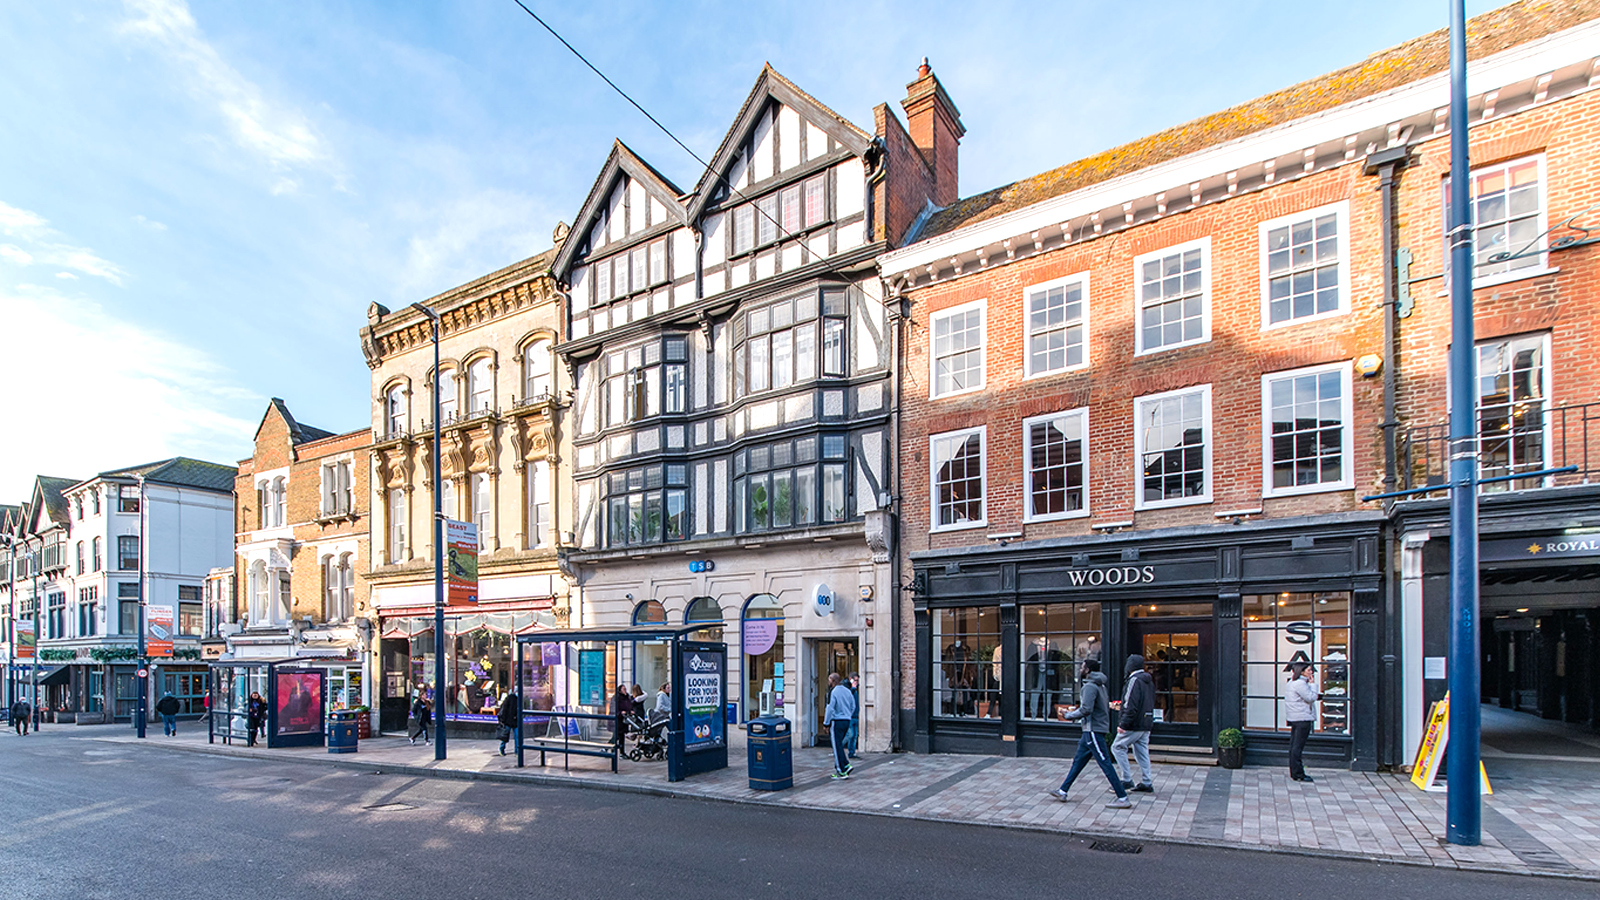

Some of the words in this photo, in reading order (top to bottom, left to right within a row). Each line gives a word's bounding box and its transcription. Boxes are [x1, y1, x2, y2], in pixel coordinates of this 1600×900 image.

[1546, 540, 1599, 553] ROYAL
[690, 561, 713, 571] TSB
[1067, 565, 1155, 586] WOODS
[688, 678, 718, 687] LOOKING
[688, 688, 701, 696] FOR
[702, 687, 718, 695] YOUR
[688, 697, 704, 705] NEXT
[704, 695, 718, 704] JOB?
